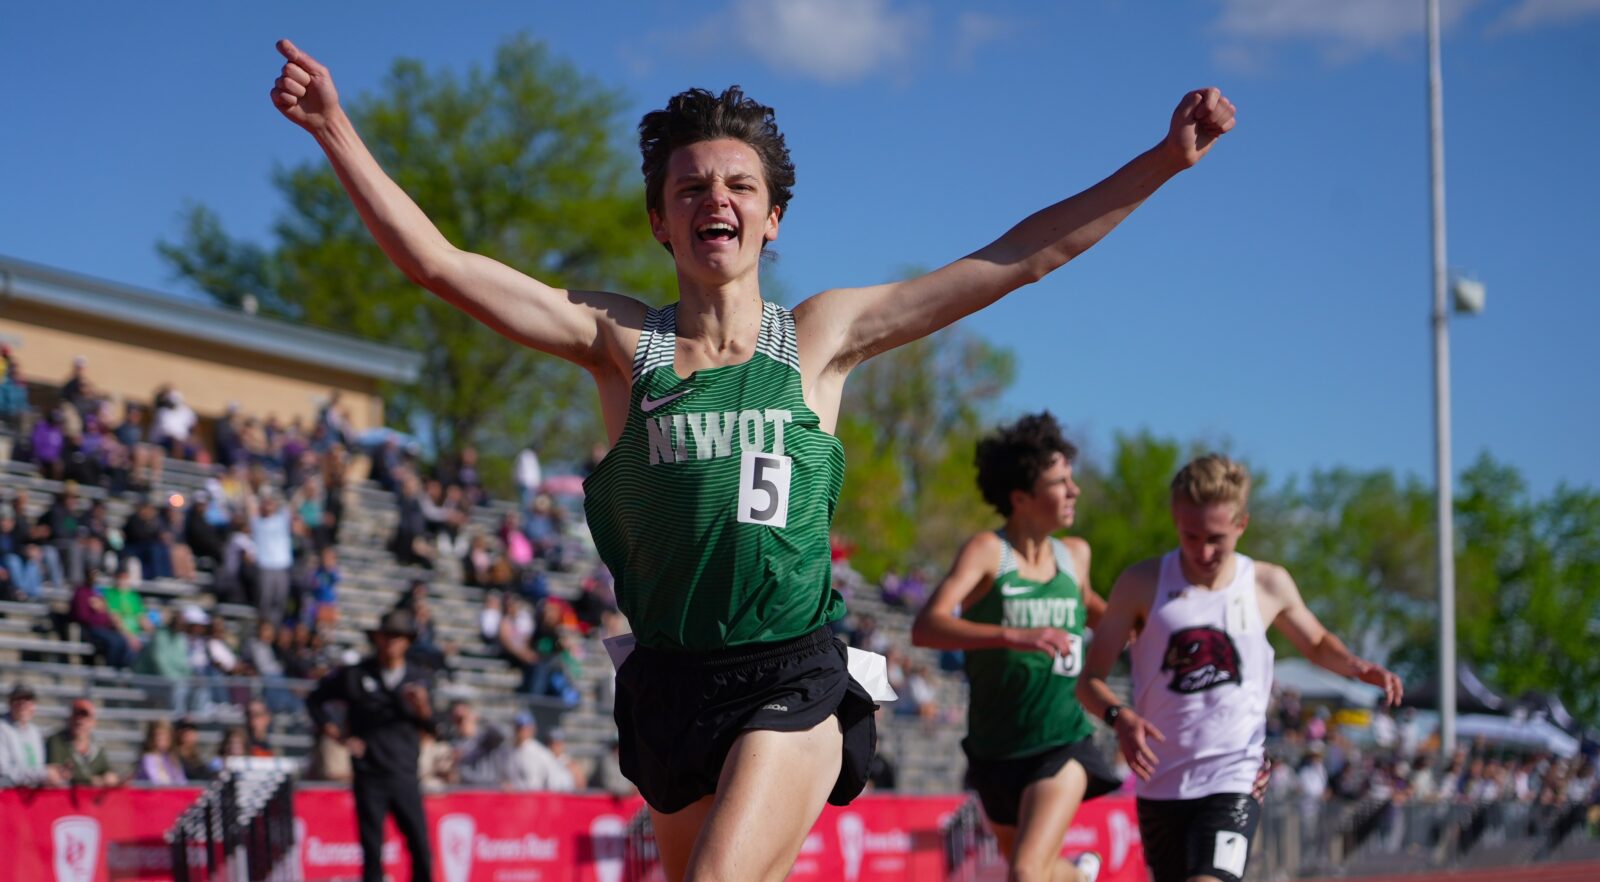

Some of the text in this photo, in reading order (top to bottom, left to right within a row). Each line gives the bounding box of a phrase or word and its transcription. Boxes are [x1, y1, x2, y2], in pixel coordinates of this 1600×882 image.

[646, 408, 792, 465] NIWOT
[750, 456, 781, 521] 5
[1002, 598, 1077, 628] NIWOT
